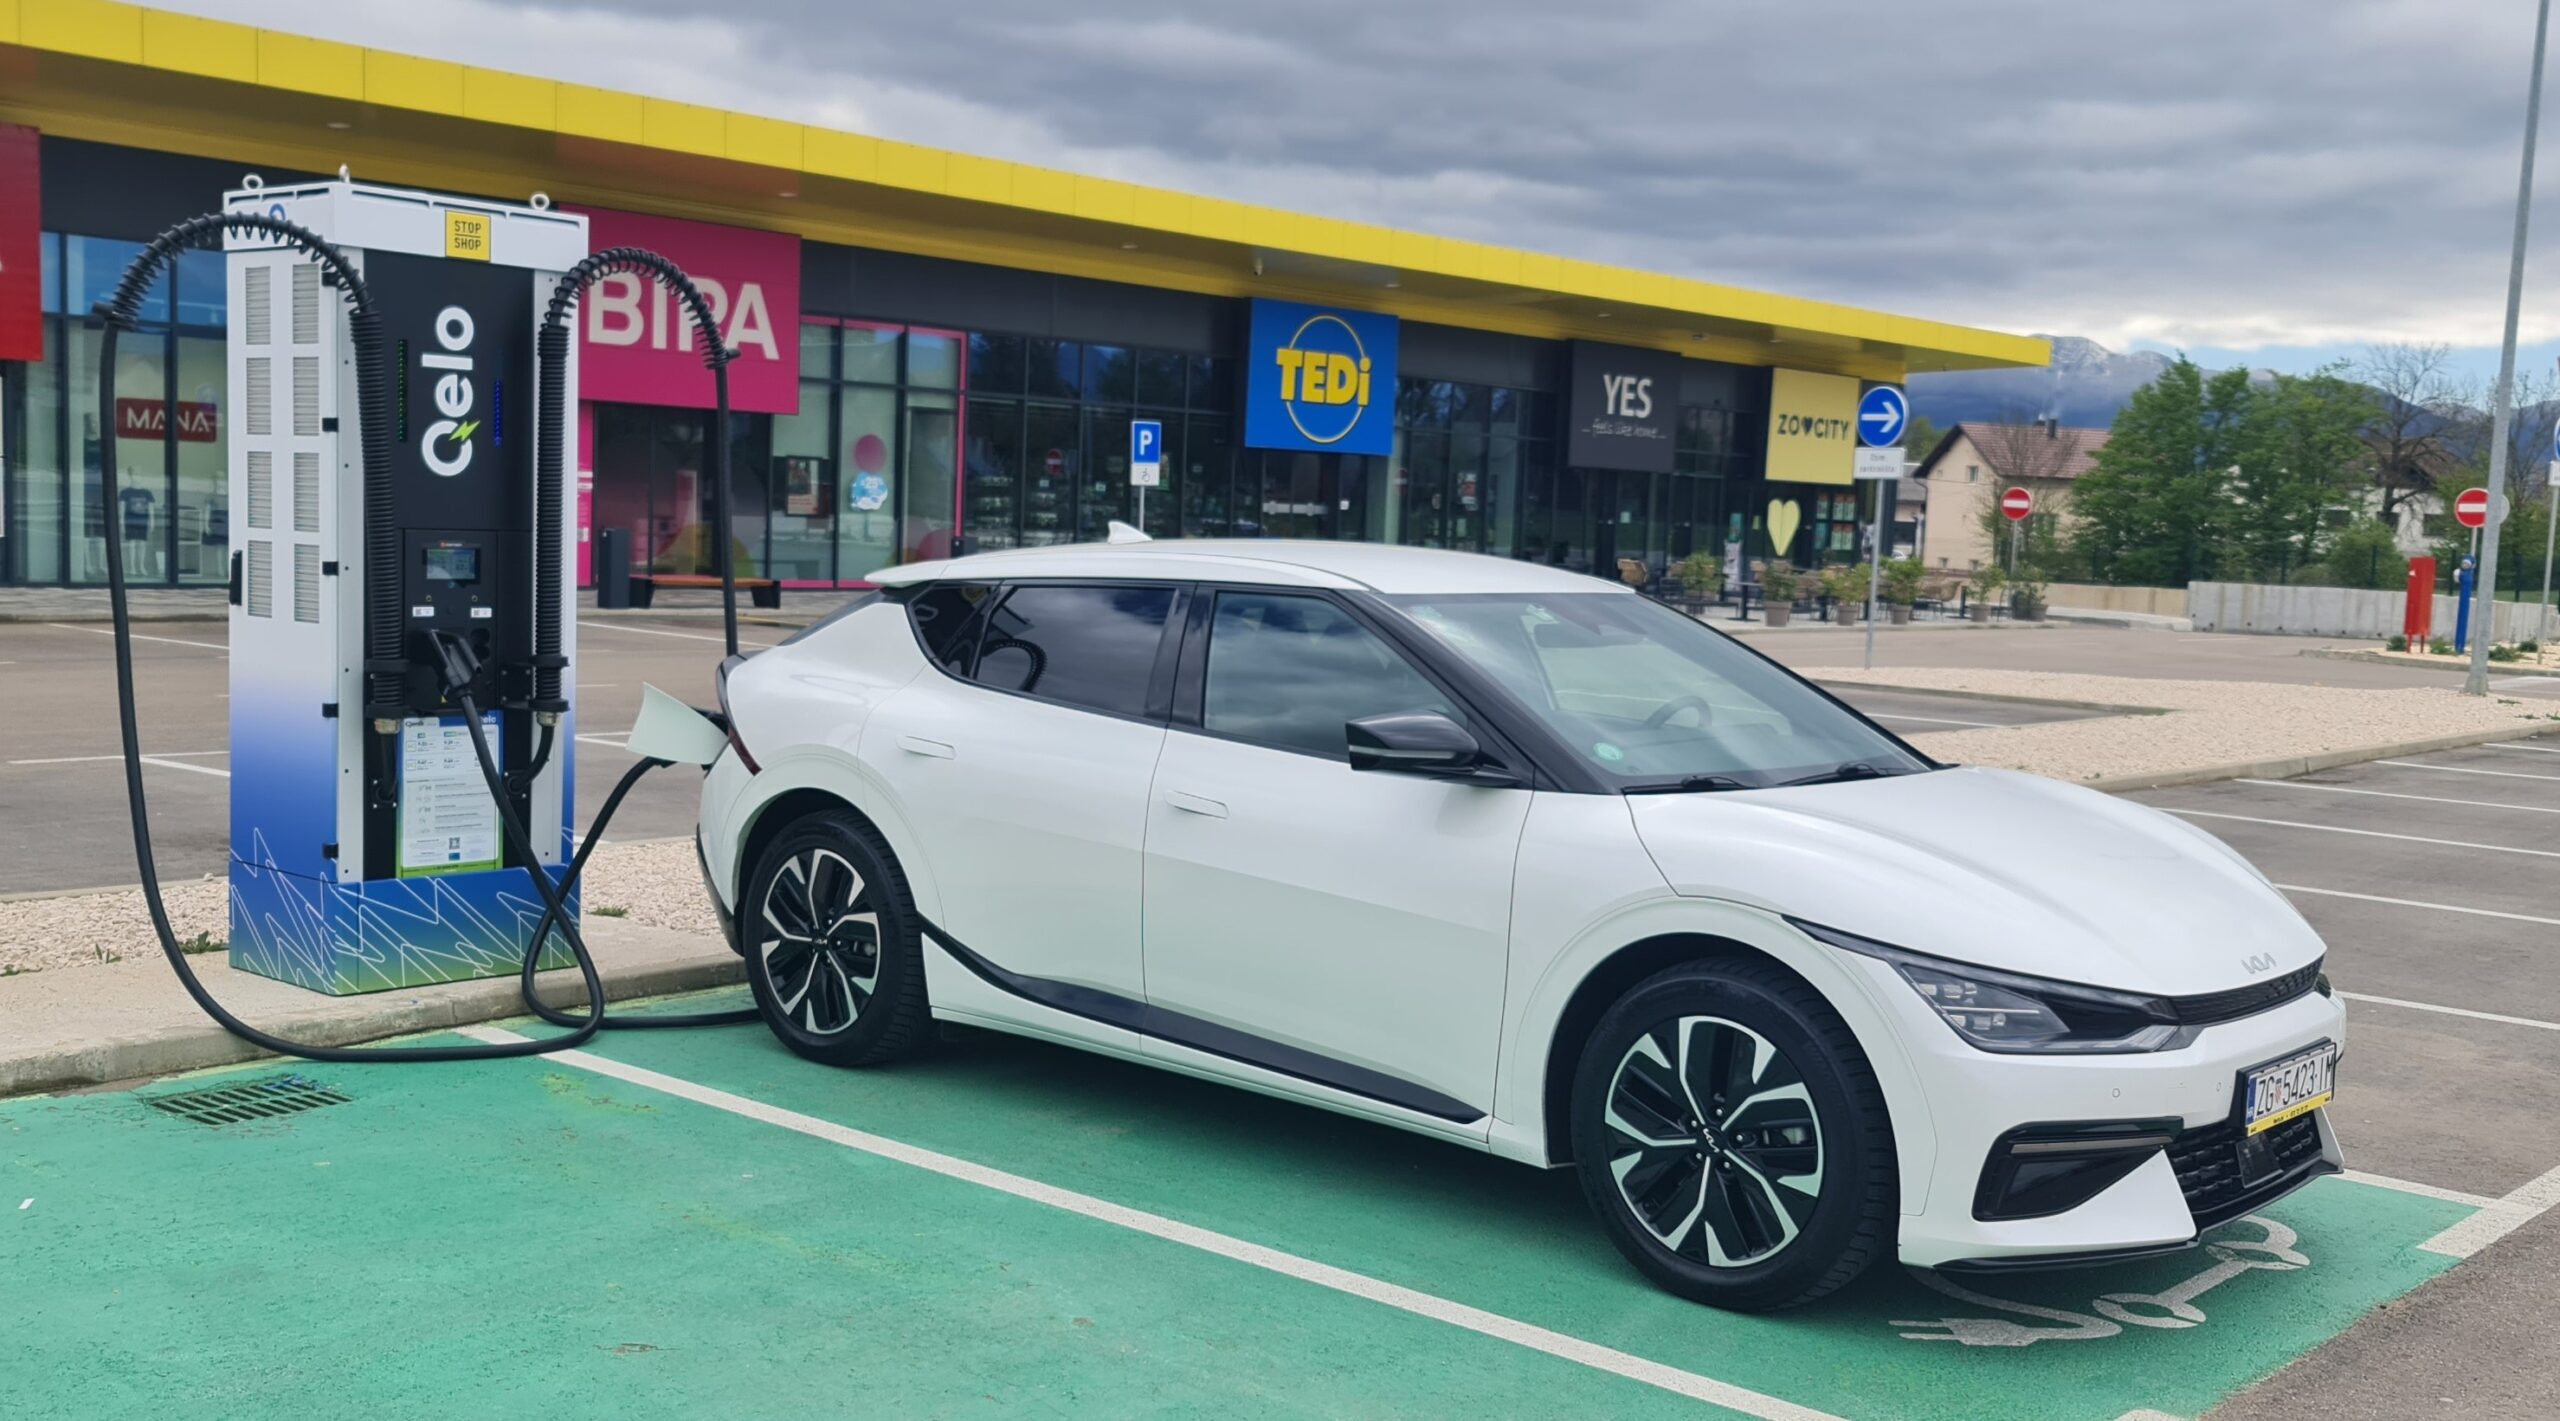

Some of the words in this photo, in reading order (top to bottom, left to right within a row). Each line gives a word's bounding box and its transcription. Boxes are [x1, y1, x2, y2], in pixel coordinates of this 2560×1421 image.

[454, 220, 482, 234] STOP
[454, 237, 482, 250] SHOP
[588, 267, 780, 361] BIPA
[421, 306, 480, 477] Qelo
[1276, 348, 1371, 406] TEDi
[1603, 374, 1652, 418] YES
[126, 406, 210, 432] MANA
[1140, 430, 1153, 456] P
[2256, 1076, 2275, 1116] ZG
